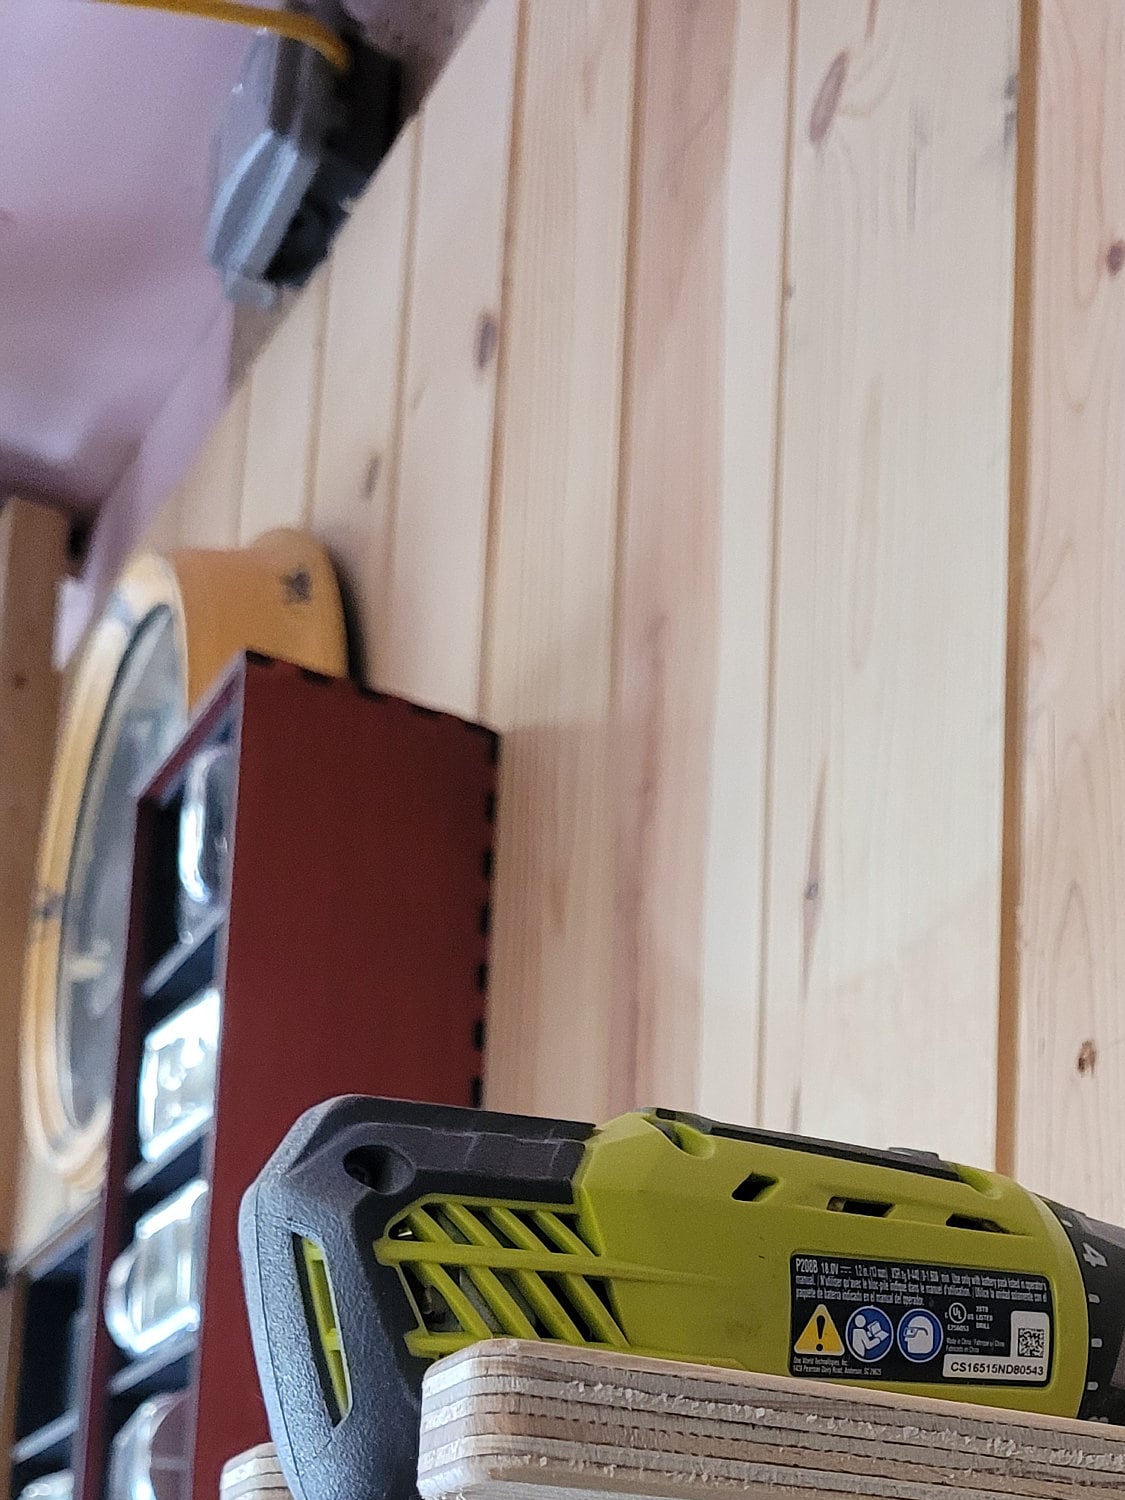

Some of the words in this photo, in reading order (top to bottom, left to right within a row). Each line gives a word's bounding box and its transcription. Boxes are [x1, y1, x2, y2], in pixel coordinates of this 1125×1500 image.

[1083, 1242, 1108, 1268] 4
[976, 1314, 993, 1322] LISTED
[950, 1361, 1044, 1376] CS16515ND80543
